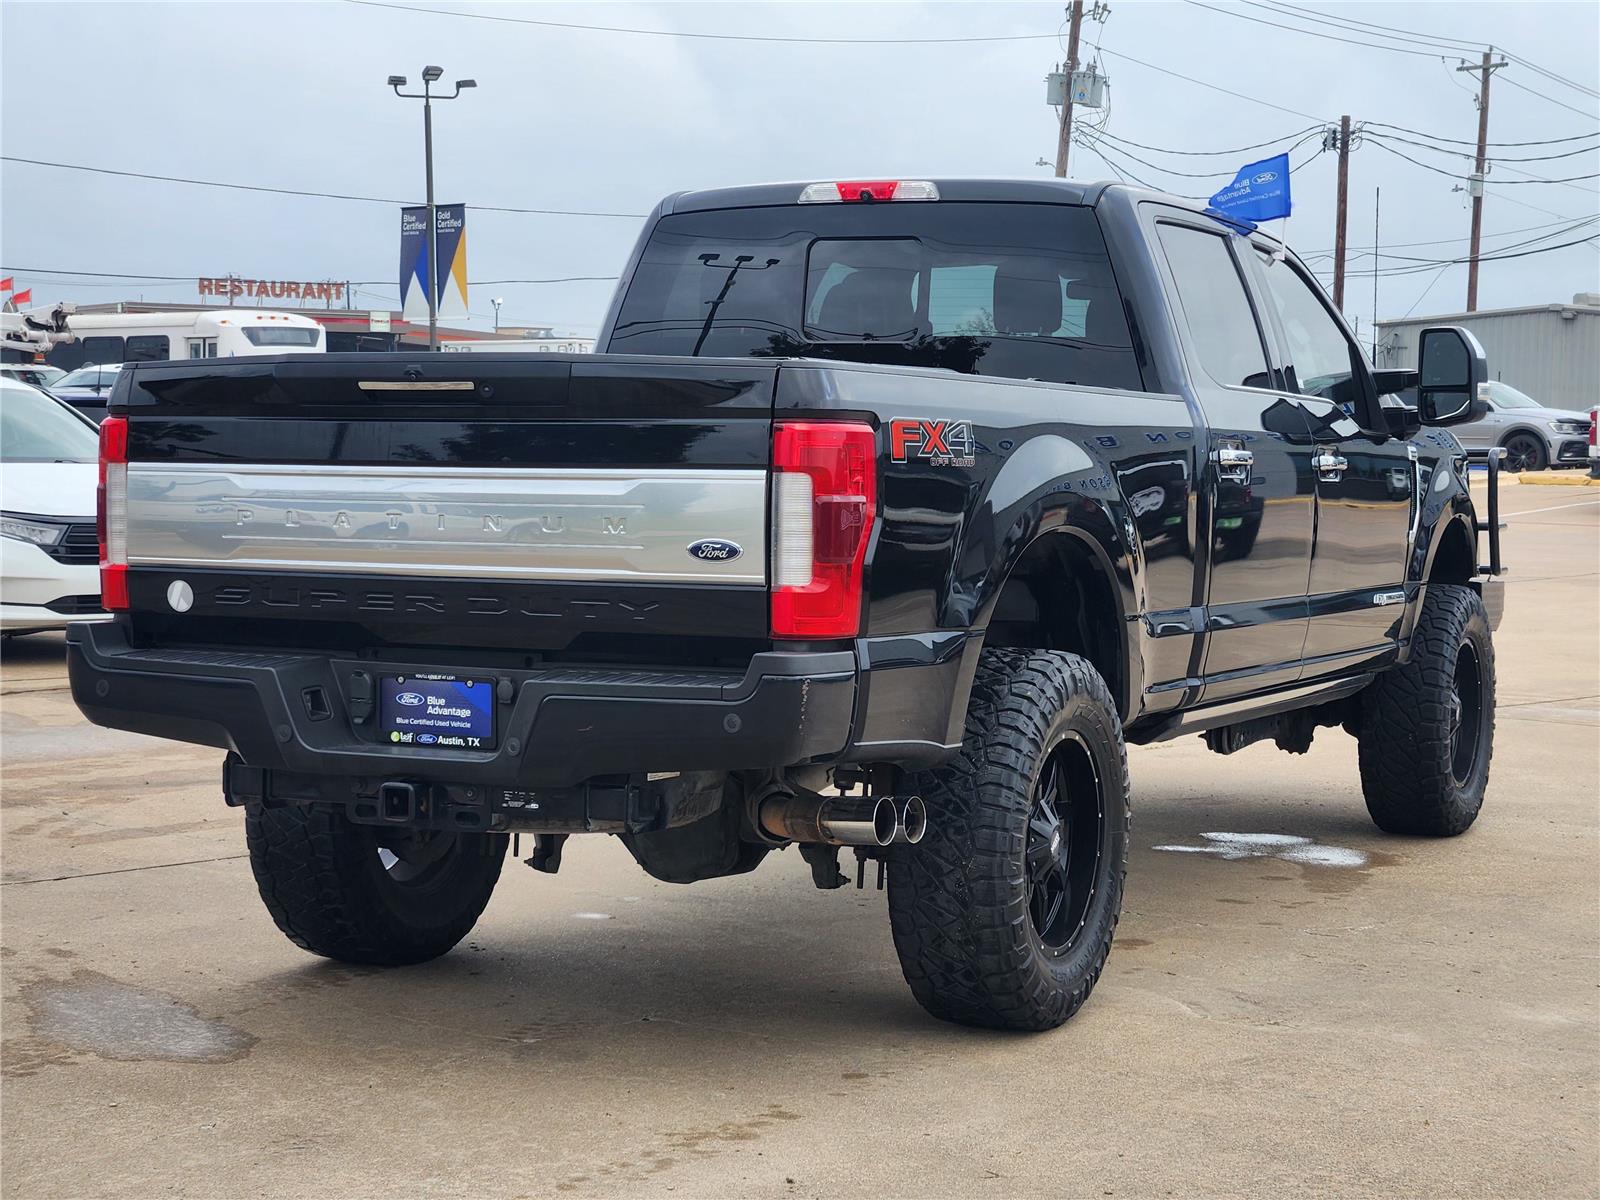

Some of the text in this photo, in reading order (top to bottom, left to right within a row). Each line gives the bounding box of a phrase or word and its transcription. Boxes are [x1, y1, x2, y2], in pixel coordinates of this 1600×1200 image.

[403, 214, 416, 222] Blue
[437, 211, 451, 219] Gold
[403, 222, 426, 230] Certified
[437, 219, 462, 228] Certified
[198, 278, 345, 300] RESTAURANT
[889, 416, 975, 463] FX4
[930, 457, 976, 468] OFF ROAD
[236, 509, 627, 535] PLATINUM
[698, 543, 729, 558] Ford
[214, 588, 660, 622] SUPER DUTY
[427, 696, 446, 706] Blue
[427, 705, 471, 717] Advantage
[409, 718, 434, 726] Certified
[450, 721, 472, 729] Vehicle
[437, 736, 480, 747] Austin, TX
